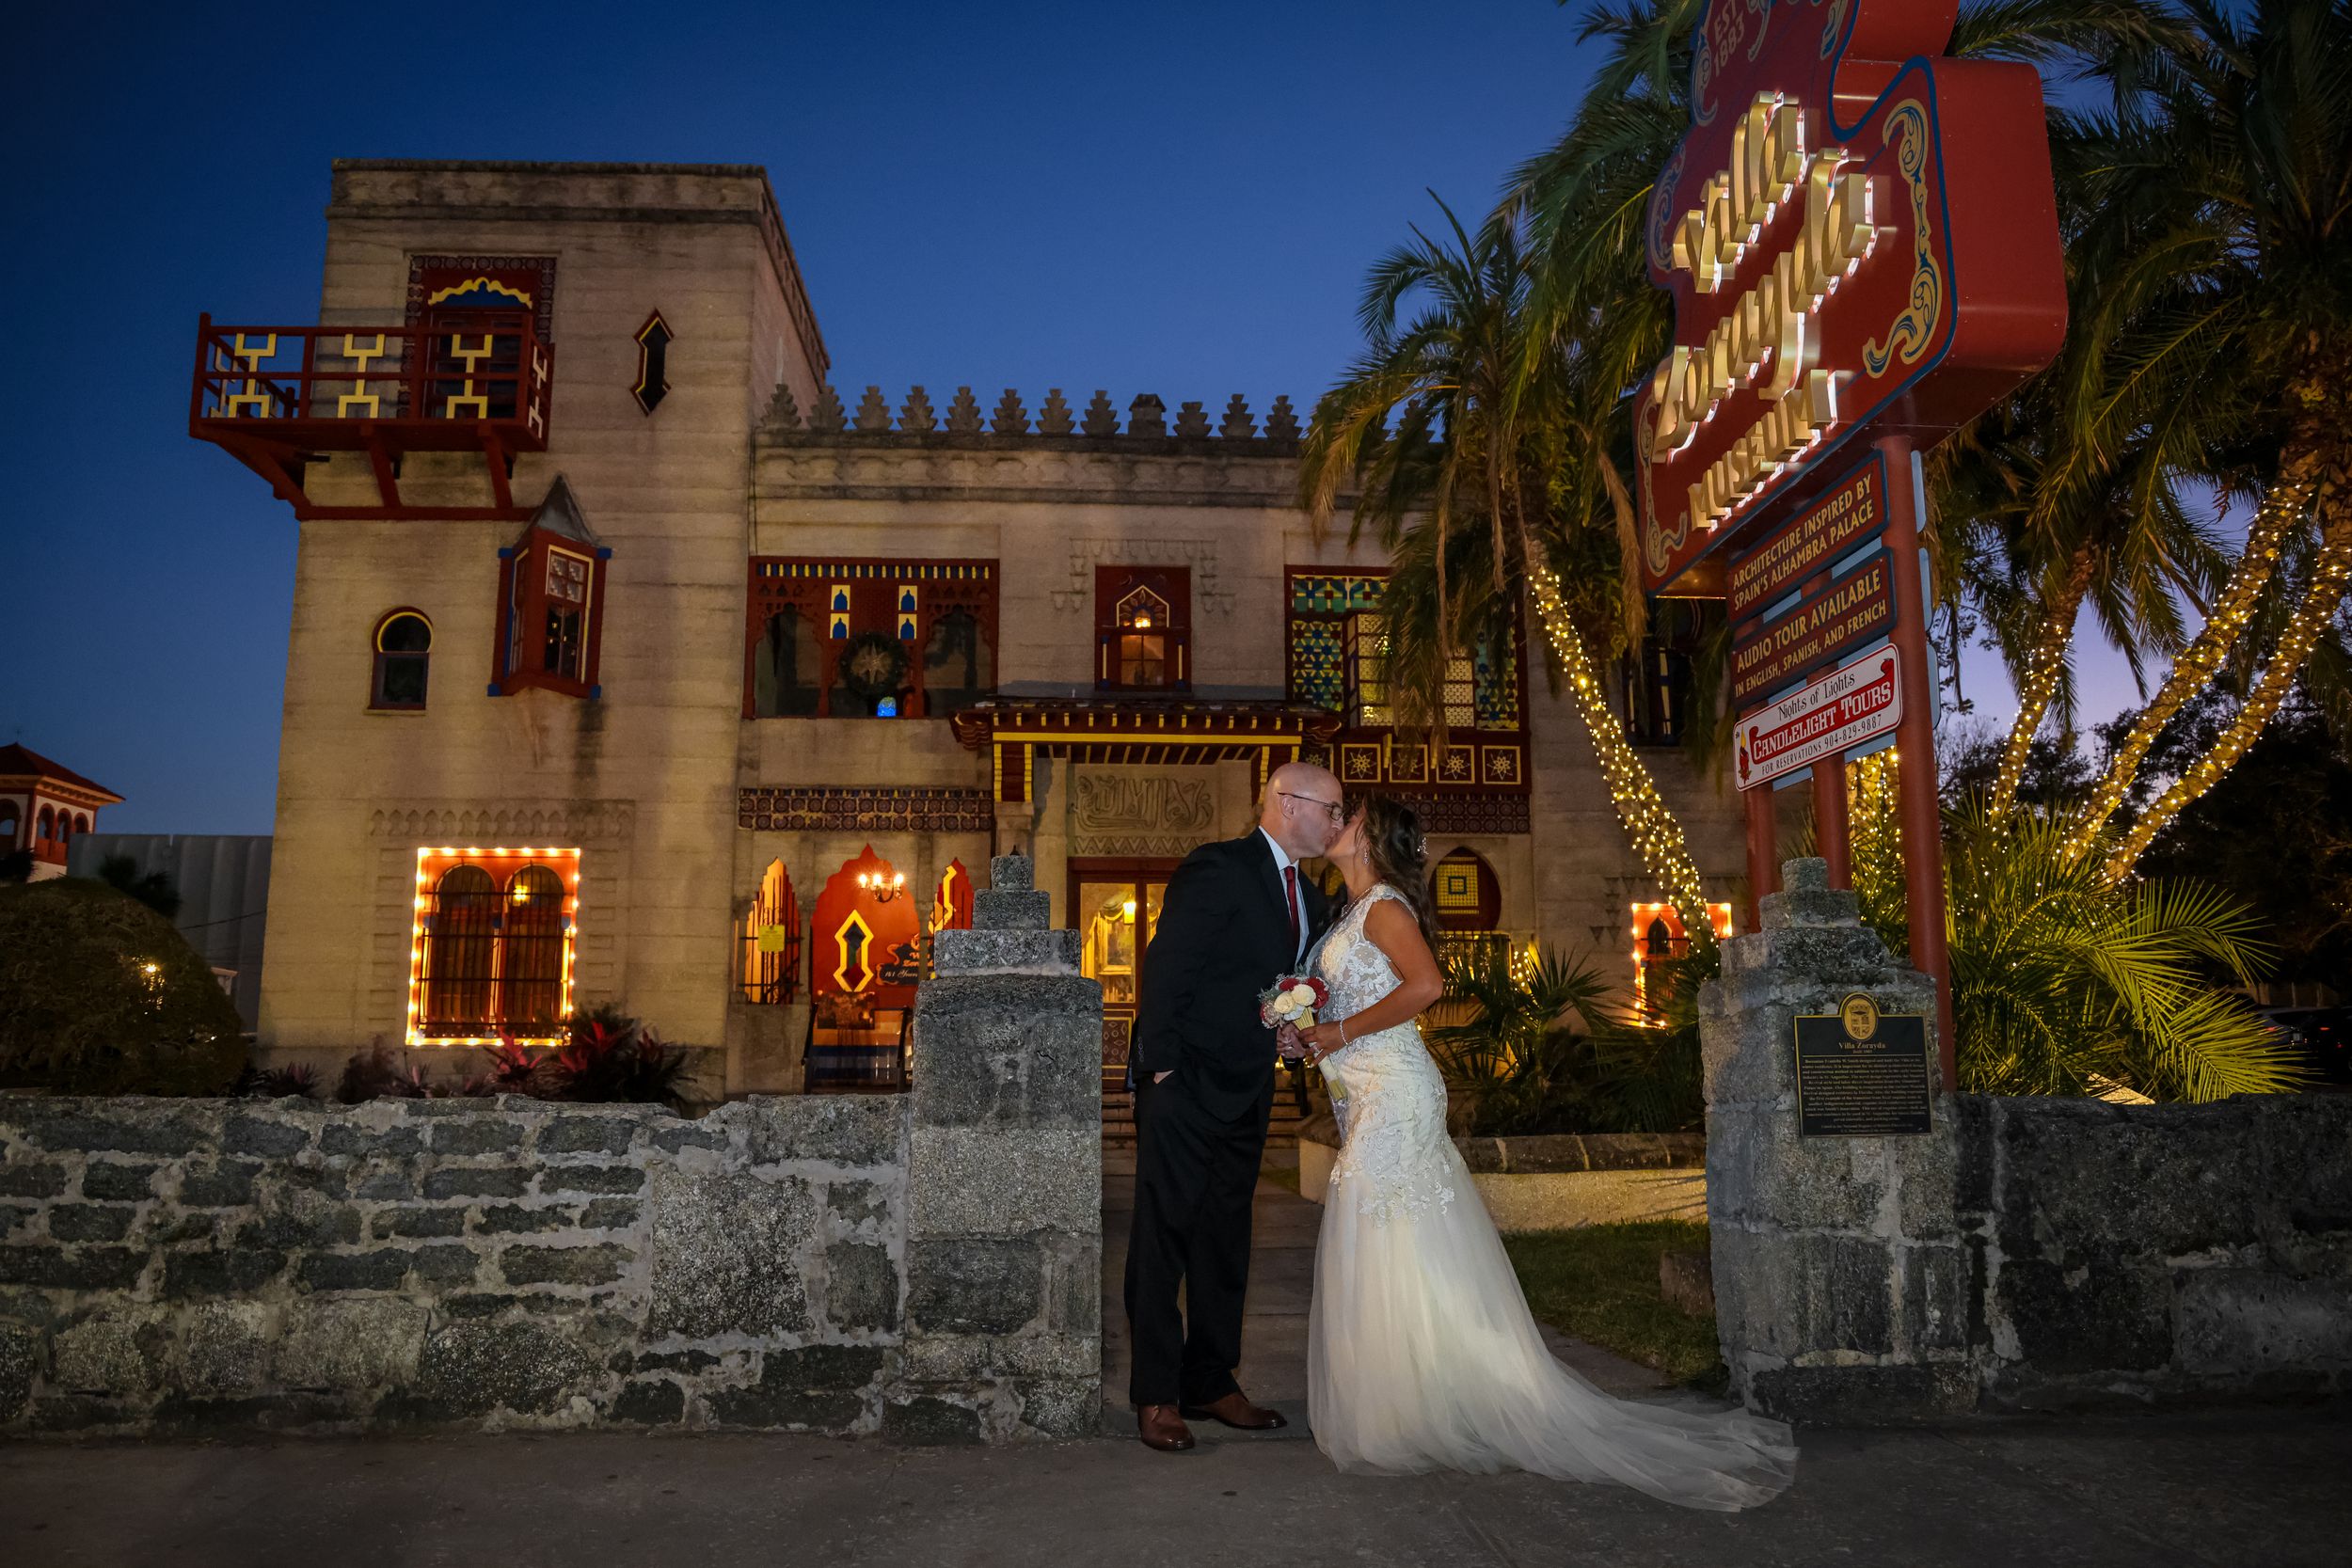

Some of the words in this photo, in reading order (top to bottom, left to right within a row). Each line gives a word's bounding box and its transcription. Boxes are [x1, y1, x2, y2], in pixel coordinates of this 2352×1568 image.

[1714, 9, 1745, 77] 1883
[1672, 91, 1804, 293] Villa
[1651, 149, 1875, 464] Zorayda
[1687, 369, 1837, 532] MUSEUM
[1733, 527, 1802, 591] ARCHITECTURE
[1804, 489, 1853, 538] INSPIRED
[1856, 473, 1871, 499] BY
[1735, 576, 1769, 610] SPAIN'S
[1771, 534, 1827, 586] ALHAMBRA
[1830, 499, 1874, 545] PALACE
[1735, 684, 1744, 698] IN
[1746, 664, 1781, 692] ENGLISH,
[1783, 639, 1821, 672] SPANISH,
[1824, 625, 1845, 649] AND
[1847, 599, 1887, 636] FRENCH
[1737, 638, 1772, 673] AUDIO
[1774, 615, 1807, 649] TOUR
[1810, 568, 1882, 629] AVAILABLE
[1753, 706, 1837, 761] CANDLELIGHT
[1841, 681, 1892, 721] TOURS
[1761, 761, 1774, 776] FOR
[1775, 740, 1822, 769] RESERVATIONS
[1824, 713, 1883, 750] 904-829-9887
[1777, 696, 1807, 721] Nights
[1810, 687, 1820, 704] of
[1822, 673, 1856, 700] Lights
[1838, 1041, 1855, 1050] Villa
